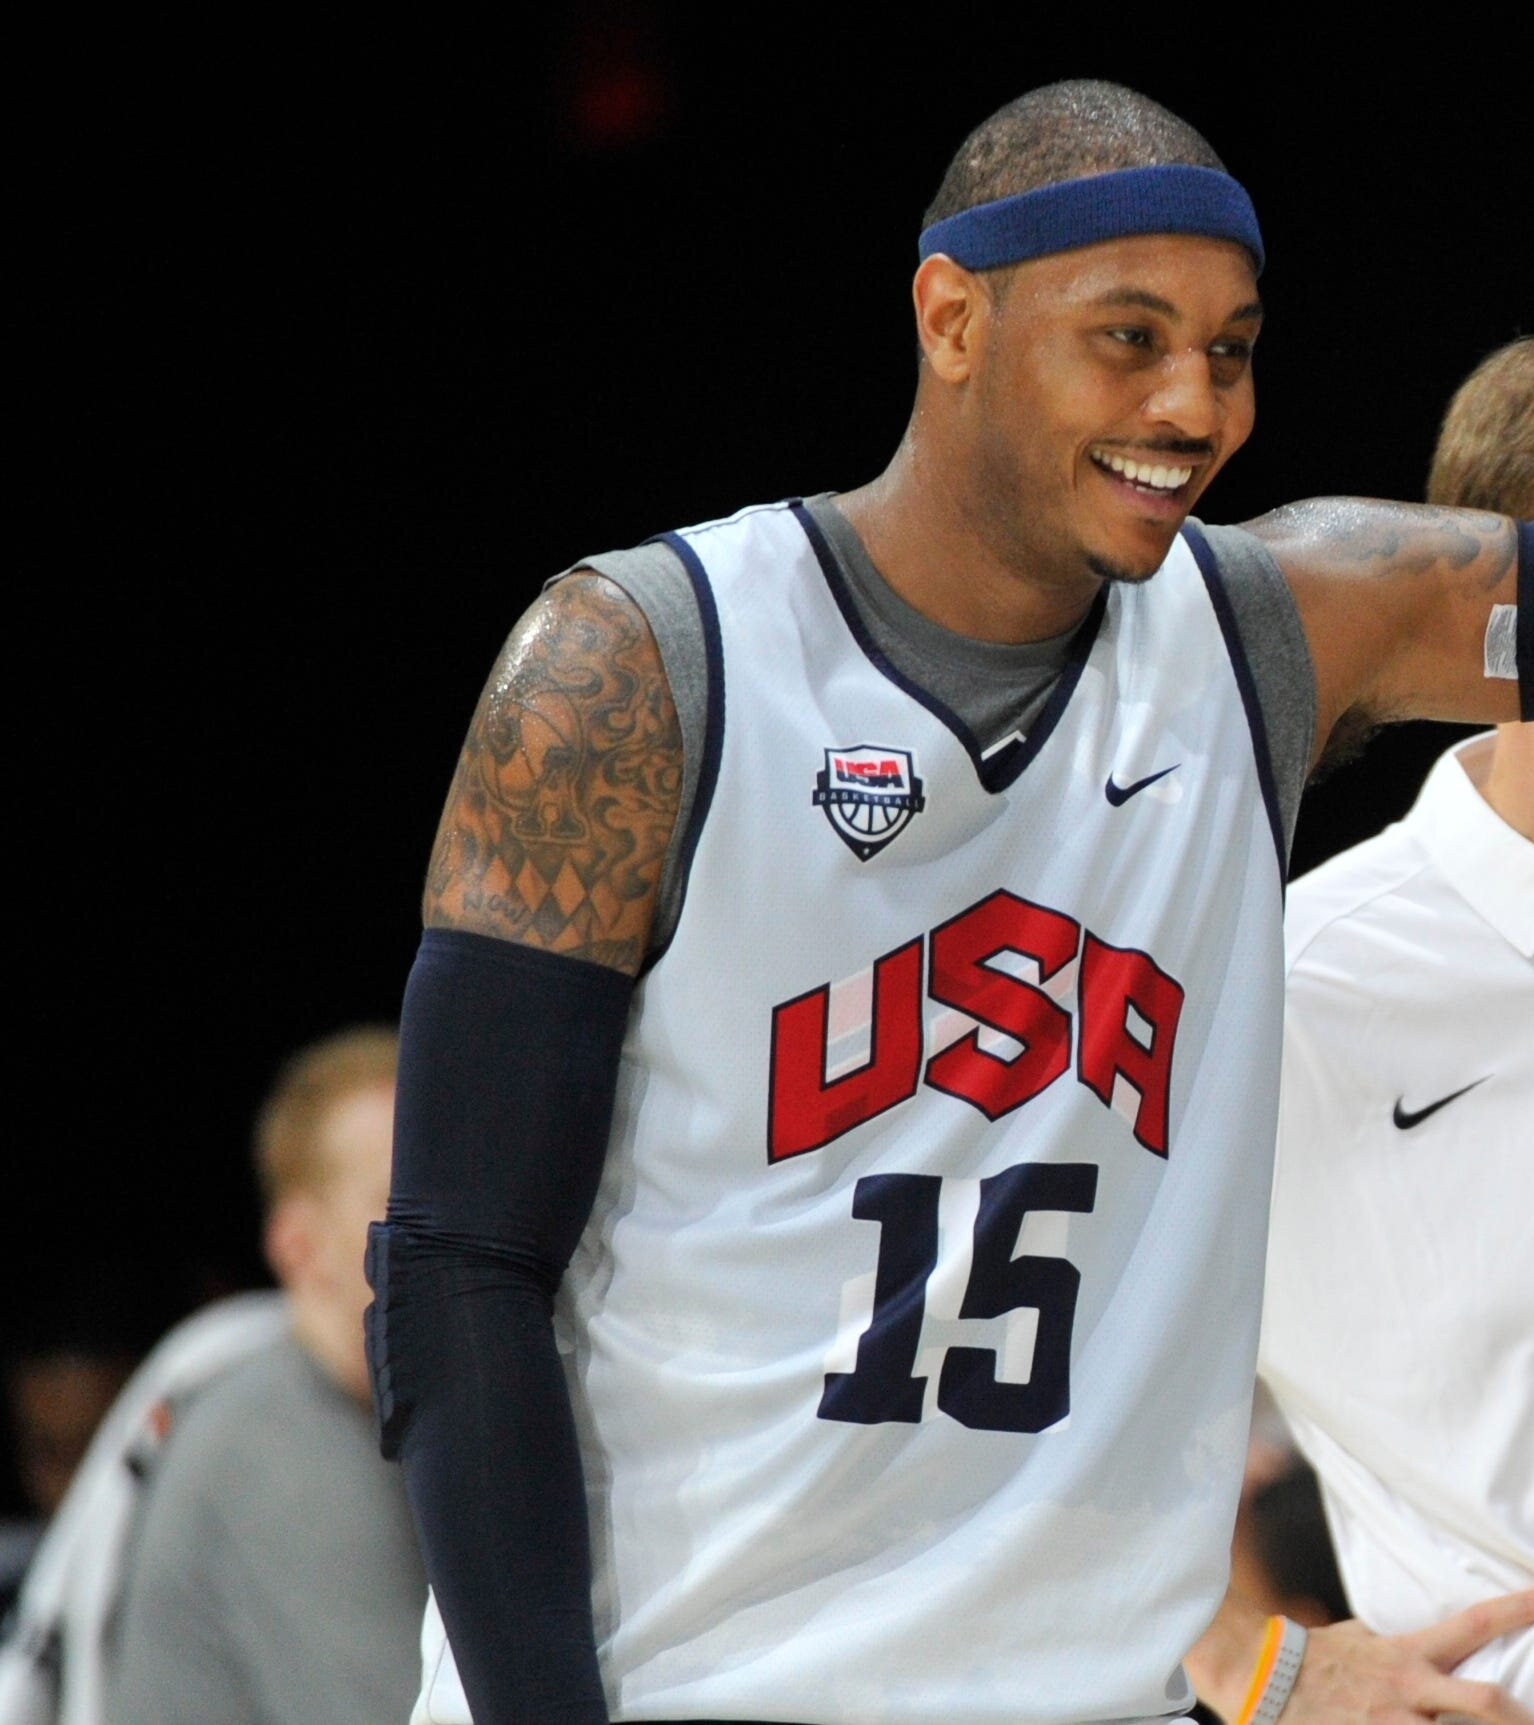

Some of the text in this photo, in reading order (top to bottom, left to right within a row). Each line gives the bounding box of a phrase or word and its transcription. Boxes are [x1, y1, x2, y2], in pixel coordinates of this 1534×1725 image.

[819, 790, 920, 810] BASKETBALL
[833, 757, 905, 789] USA
[767, 887, 1185, 1165] USA
[816, 1162, 1100, 1433] 15
